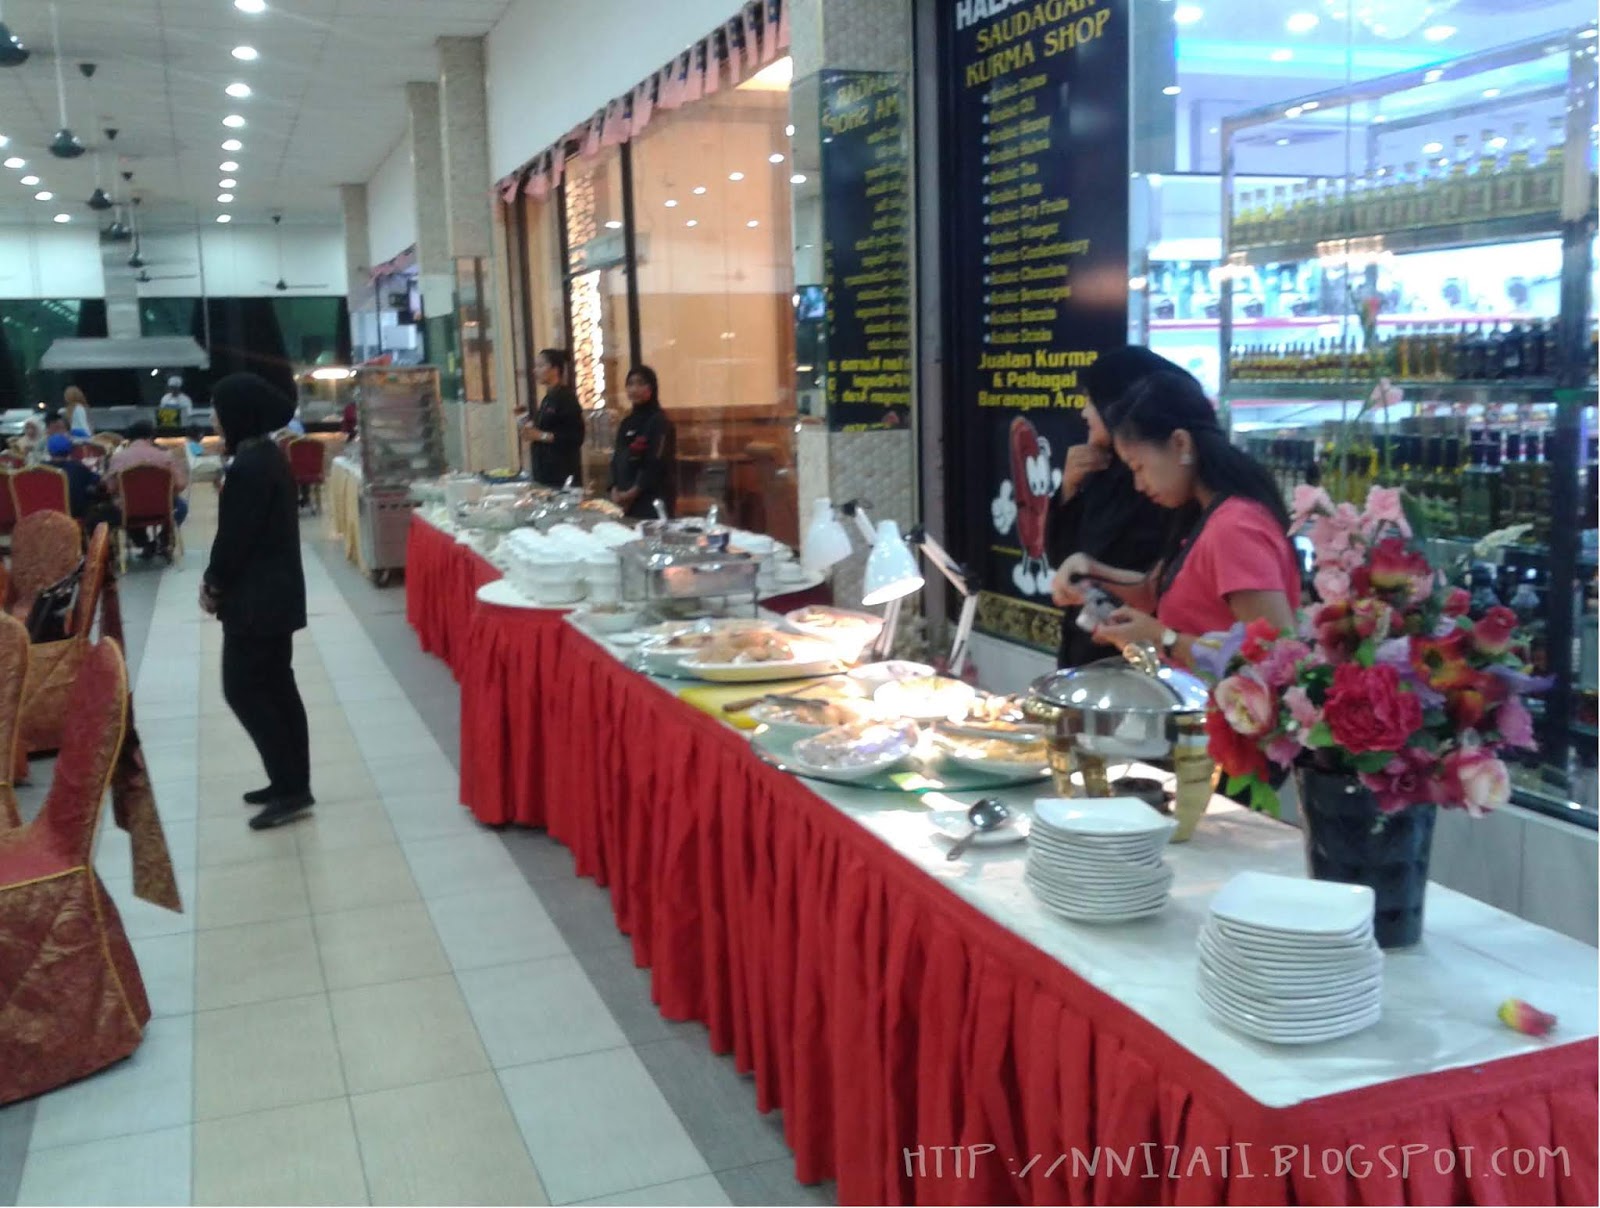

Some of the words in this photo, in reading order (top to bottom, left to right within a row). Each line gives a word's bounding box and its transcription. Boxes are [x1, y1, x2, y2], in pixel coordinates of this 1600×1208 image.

[966, 41, 1036, 87] KURMA
[1043, 8, 1111, 56] SHOP
[978, 350, 1032, 369] Jualan
[1035, 348, 1099, 368] Kurma
[1007, 370, 1078, 391] Pelbagai
[978, 391, 1050, 411] Barangan
[1053, 390, 1087, 409] Ara
